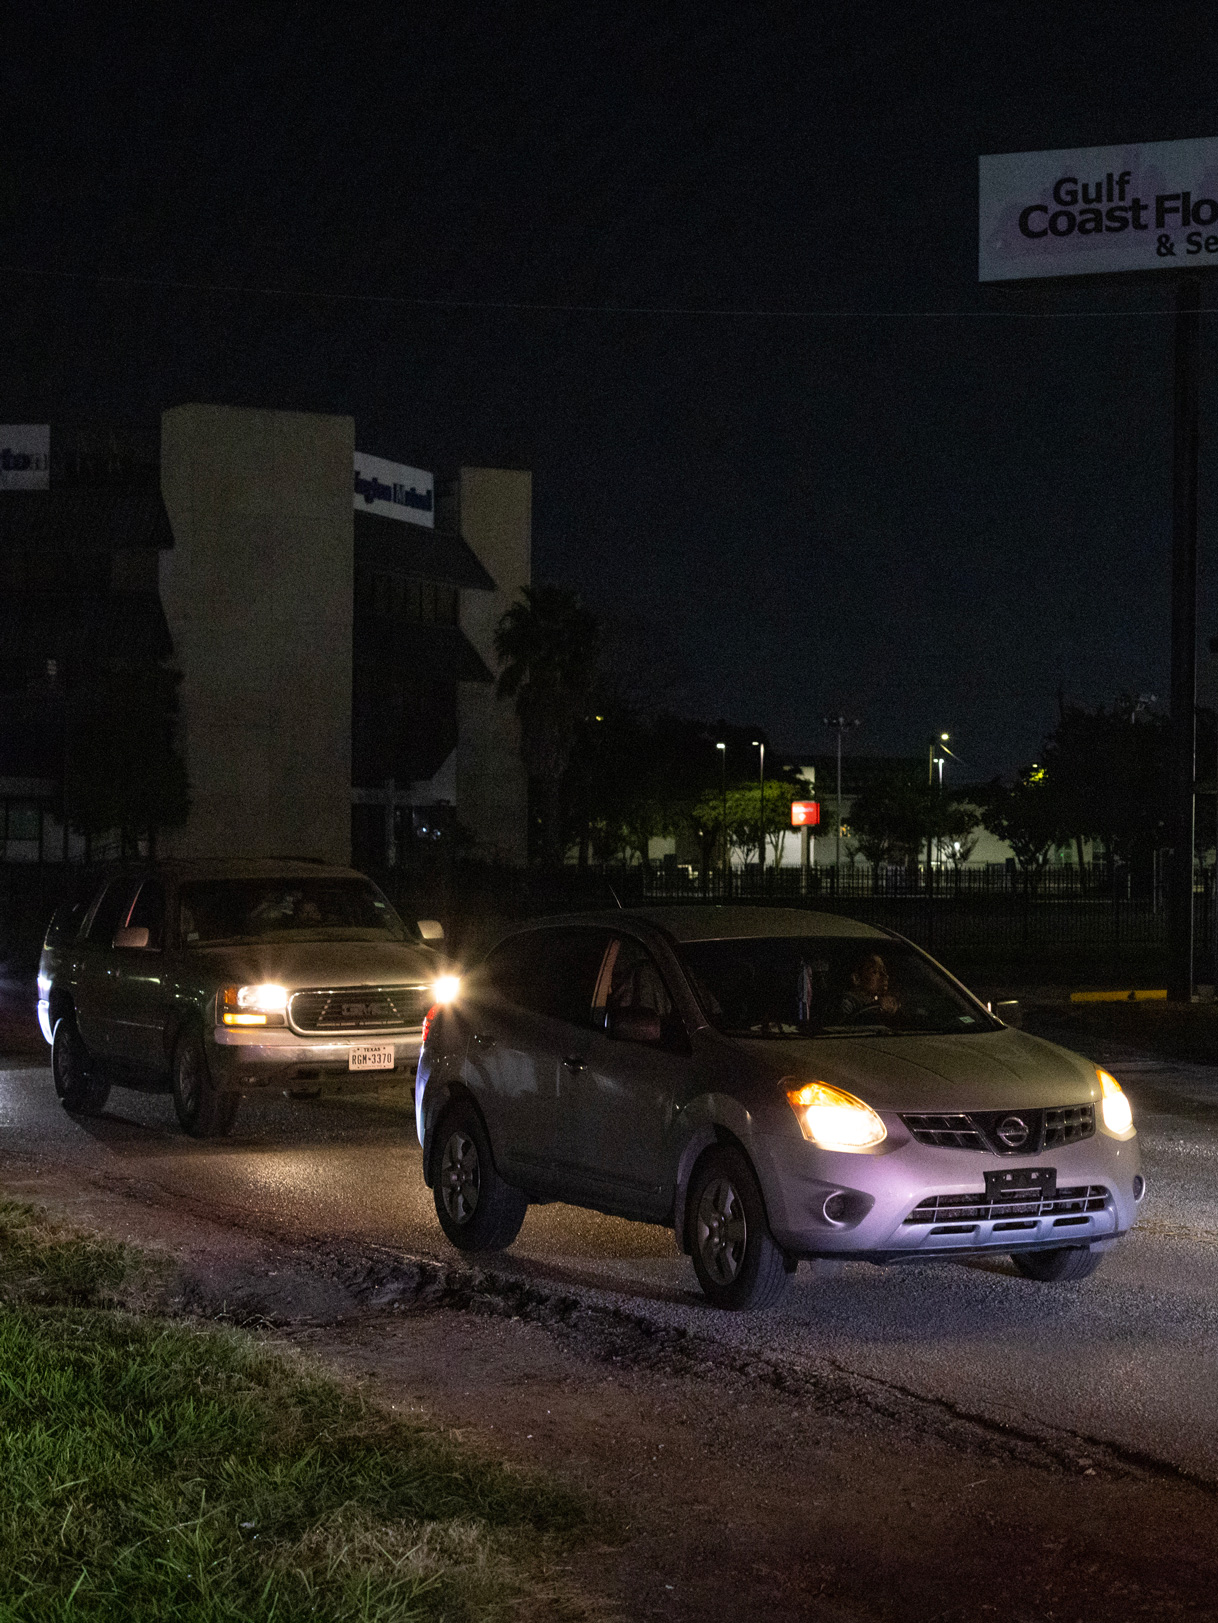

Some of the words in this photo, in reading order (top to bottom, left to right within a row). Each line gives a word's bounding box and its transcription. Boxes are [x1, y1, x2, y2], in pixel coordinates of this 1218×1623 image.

[1053, 171, 1131, 207] Gulf
[1018, 197, 1149, 239] Coast
[1156, 233, 1176, 257] &
